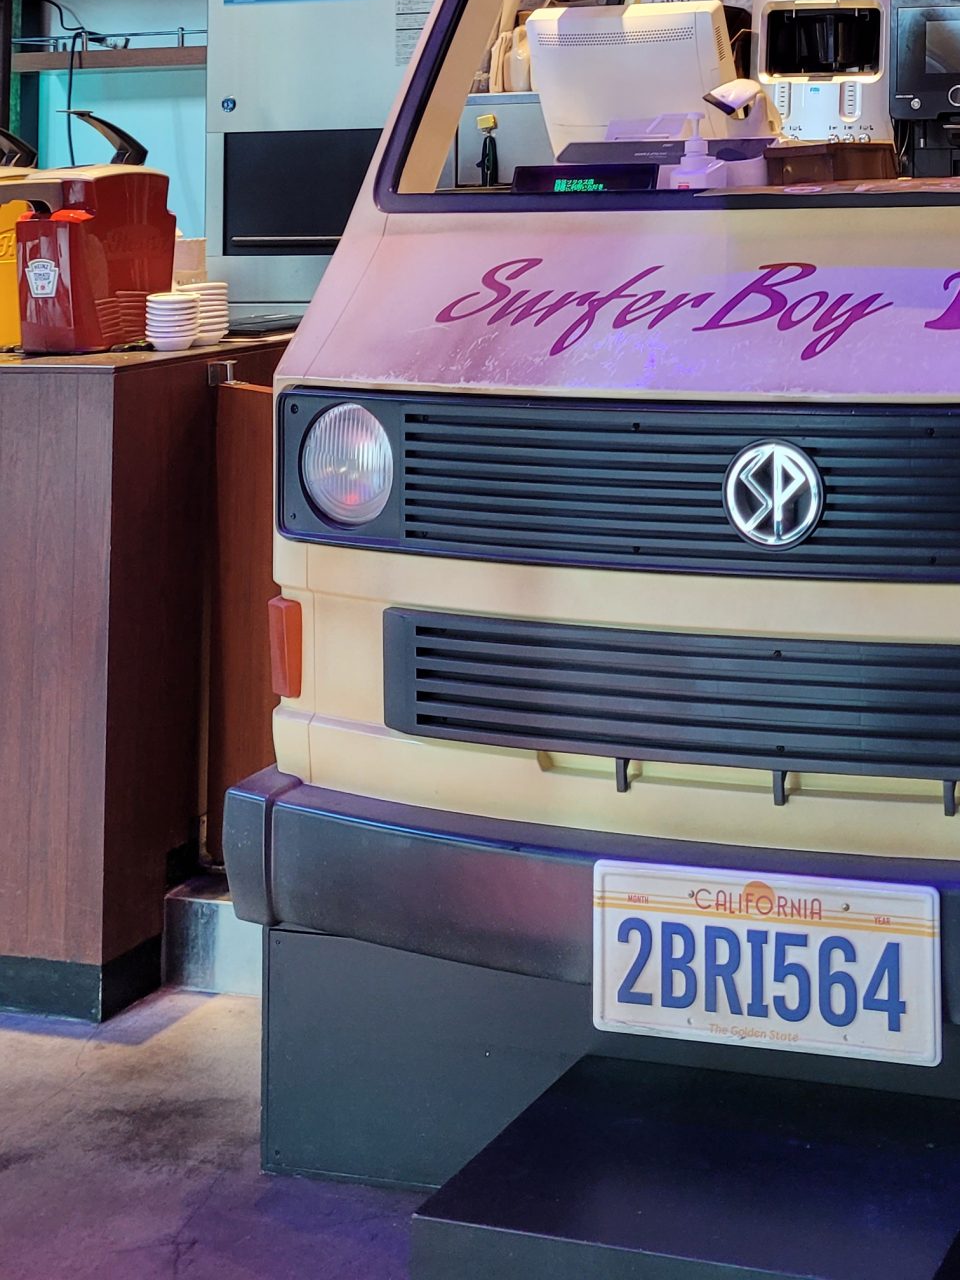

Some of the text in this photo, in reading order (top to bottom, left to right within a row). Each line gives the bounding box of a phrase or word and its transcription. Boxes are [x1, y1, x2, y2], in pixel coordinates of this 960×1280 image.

[436, 256, 716, 358] Surfer
[692, 262, 895, 360] Boy
[627, 894, 649, 905] MONTH
[694, 888, 823, 921] CALIFORNIA
[873, 915, 892, 926] YEAR
[616, 917, 907, 1033] 2BRI564
[708, 1023, 800, 1042] The Golden State
